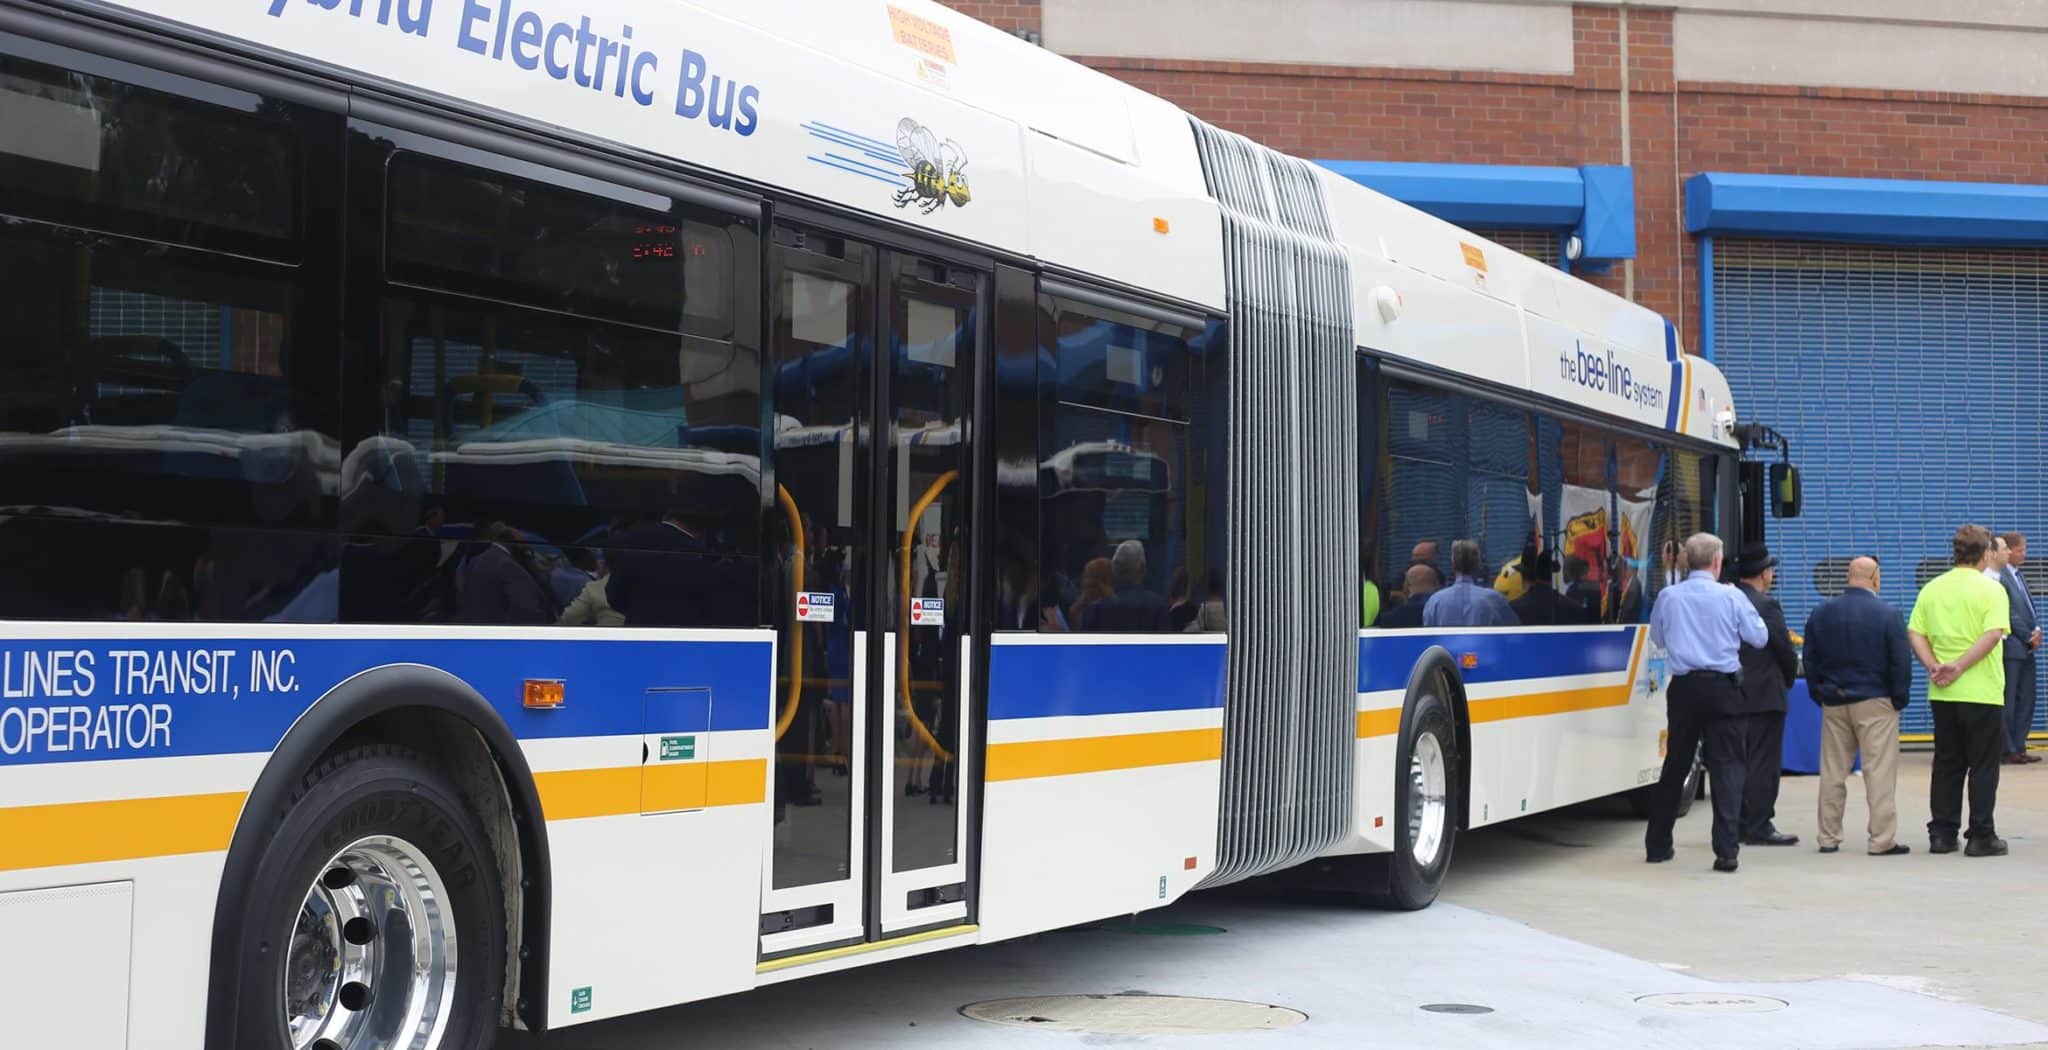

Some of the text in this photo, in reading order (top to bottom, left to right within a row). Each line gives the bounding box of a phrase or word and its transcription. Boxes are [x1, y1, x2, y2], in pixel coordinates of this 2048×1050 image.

[457, 0, 761, 137] Electric Bus
[1560, 351, 1576, 382] the
[1633, 382, 1663, 410] system
[810, 595, 832, 605] NOTICE
[923, 601, 942, 609] NOTICE
[3, 649, 300, 700] LINES TRANSIT, INC.
[1, 703, 173, 755] OPERATOR
